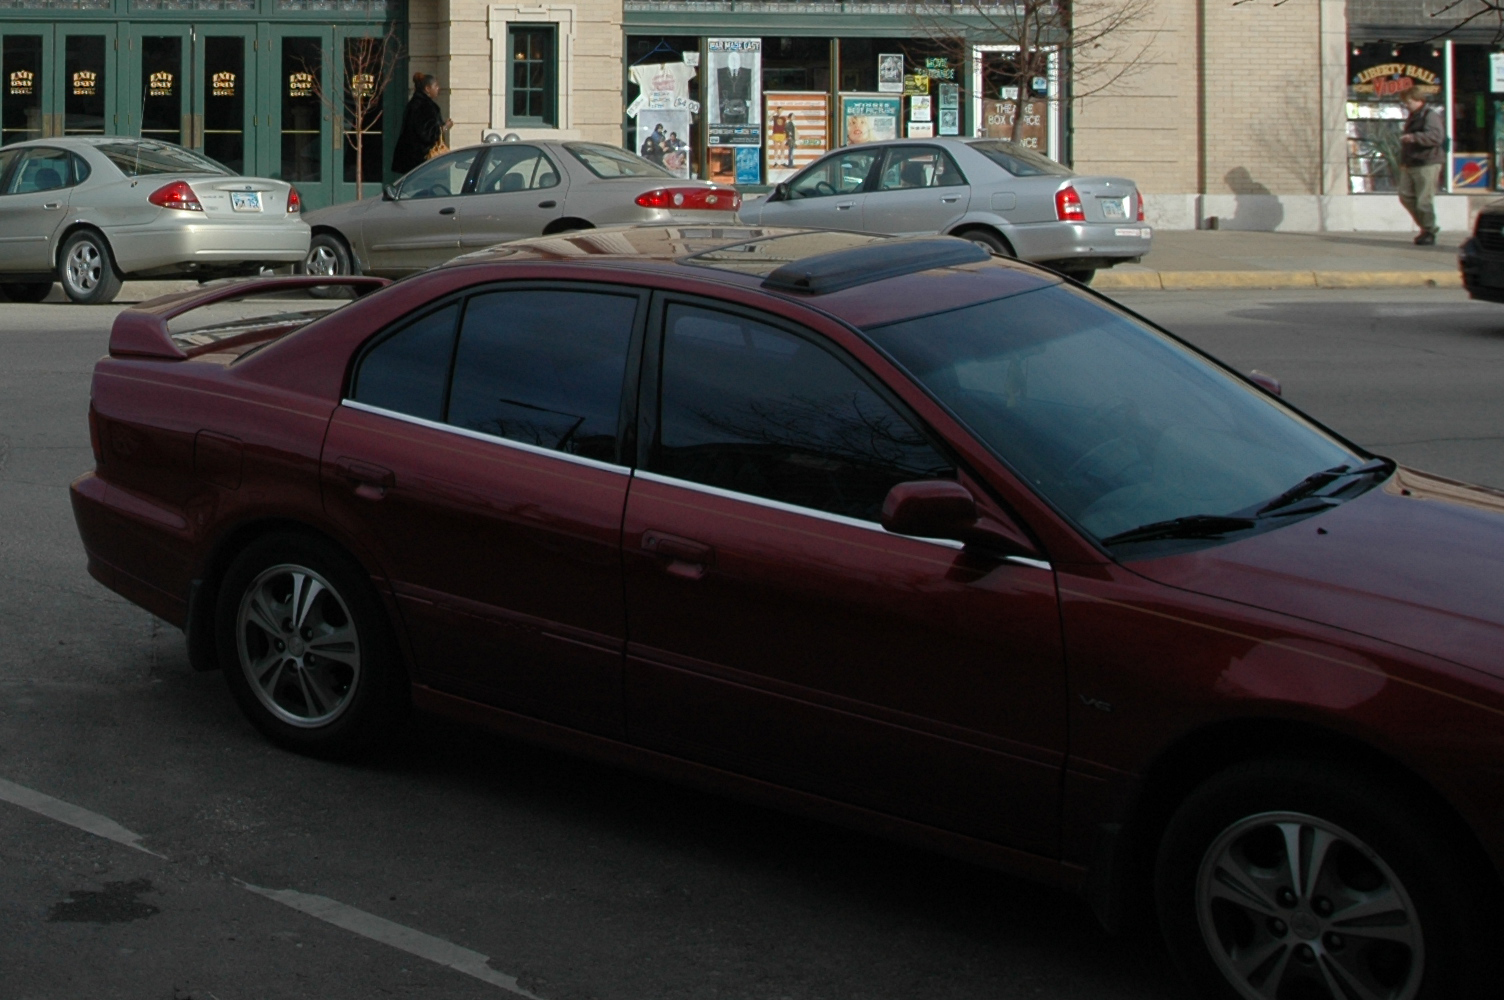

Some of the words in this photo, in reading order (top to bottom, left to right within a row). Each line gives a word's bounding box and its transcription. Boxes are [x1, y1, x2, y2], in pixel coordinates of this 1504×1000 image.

[10, 70, 33, 80] EXIT
[73, 71, 96, 81] EXIT
[150, 72, 173, 82] EXIT
[212, 72, 235, 82] EXIT
[290, 72, 313, 82] EXIT
[1357, 64, 1406, 83] LIBERTY
[1406, 65, 1436, 84] HALL
[988, 115, 1006, 125] BOX
